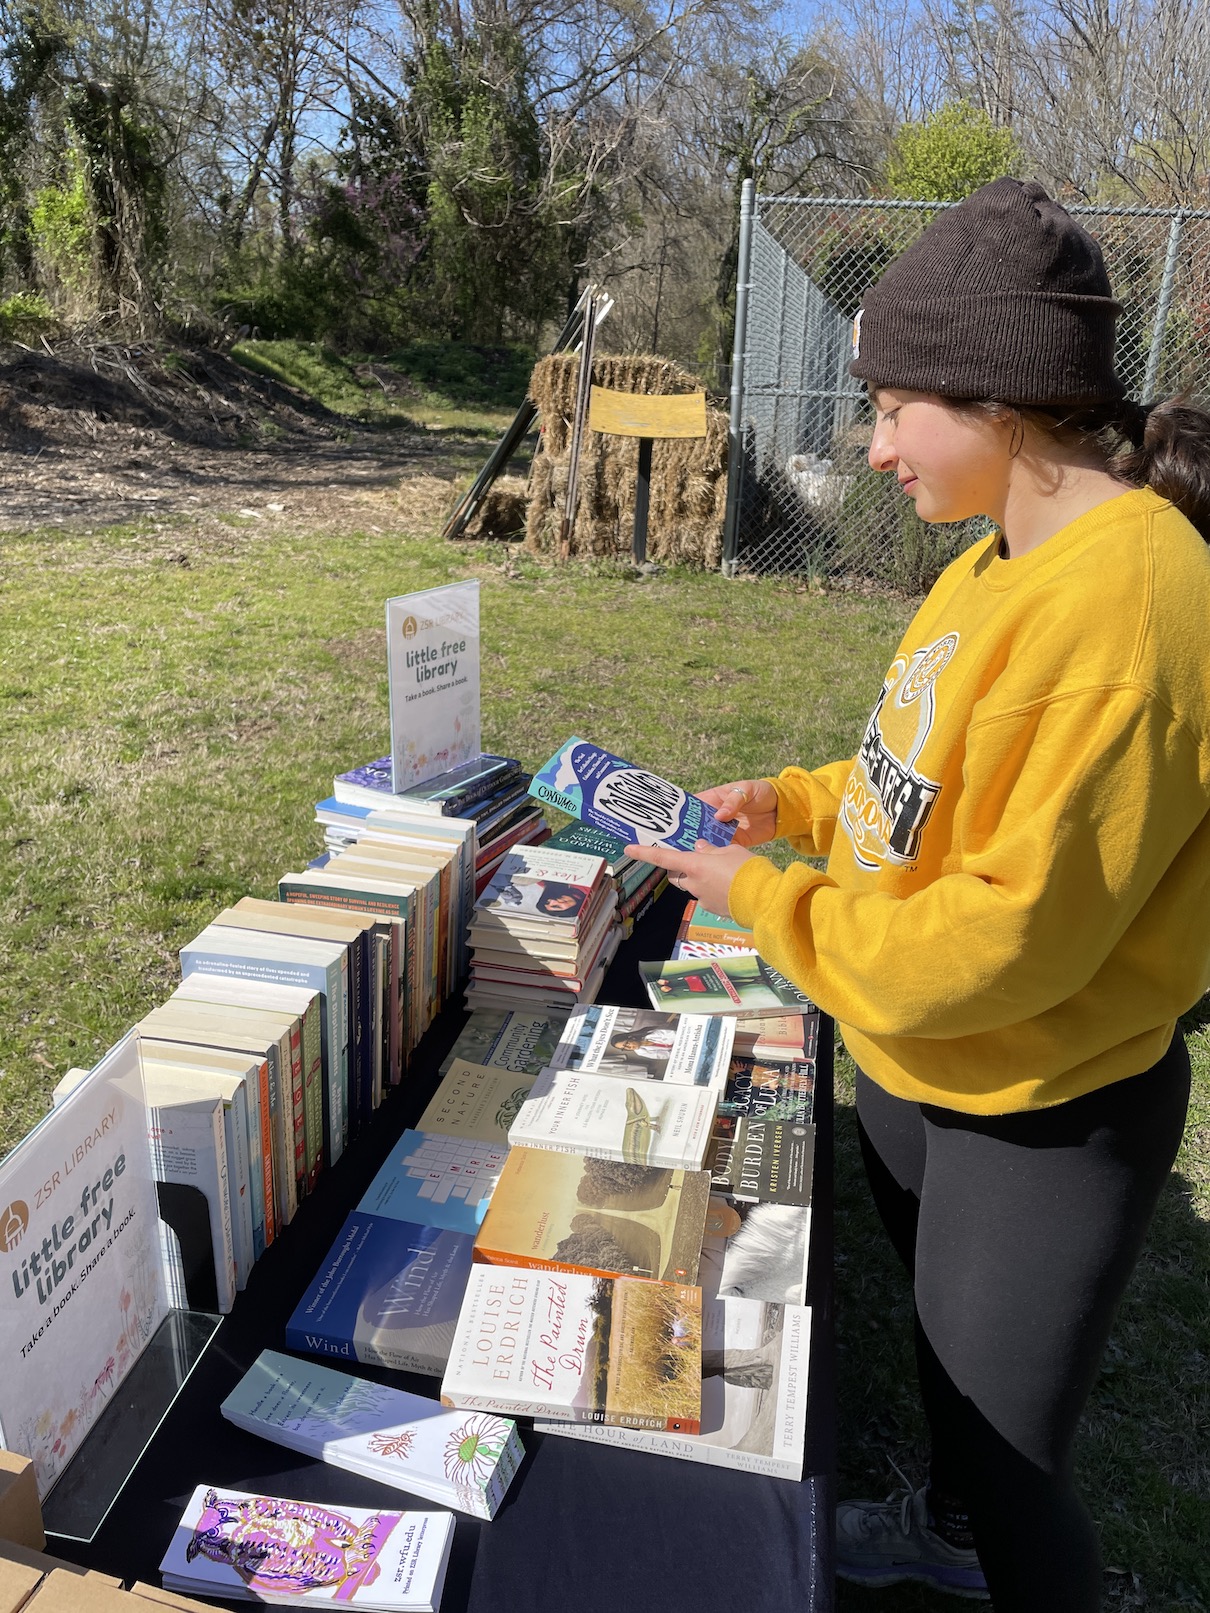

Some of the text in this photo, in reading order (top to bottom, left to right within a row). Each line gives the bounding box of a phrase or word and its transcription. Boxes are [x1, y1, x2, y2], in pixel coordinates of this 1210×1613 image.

[406, 640, 466, 668] little free
[416, 660, 458, 684] library
[405, 692, 417, 703] Take
[422, 686, 435, 696] book.
[437, 681, 450, 693] Share
[455, 676, 468, 687] book.
[538, 785, 577, 813] CONSUMED
[599, 772, 680, 833] CONSUMED
[686, 796, 703, 828] BARBER
[570, 835, 613, 848] WILSON
[570, 840, 616, 854] EDWARD
[535, 869, 583, 882] Alex &
[723, 933, 747, 944] Everyday
[198, 966, 228, 974] transformed
[242, 972, 278, 980] unprecedented
[279, 975, 308, 984] catastrophe
[202, 960, 246, 970] adrenaline-fueled
[277, 969, 299, 977] upended
[765, 966, 792, 991] ANNA
[331, 1002, 339, 1076] Displacements
[494, 1023, 528, 1067] Community
[506, 1021, 548, 1074] Gardening
[585, 1006, 615, 1069] What the Eyes Don't See
[684, 1023, 703, 1074] Mona Hanna-Attisha
[266, 1060, 276, 1107] Alex Me
[437, 1071, 471, 1123] SECOND
[451, 1074, 485, 1125] NATURE
[563, 1077, 580, 1096] FISH
[752, 1069, 781, 1117] OF LUNA
[796, 1063, 808, 1124] ULIA BUTTERFLY HILL
[549, 1117, 560, 1135] YOUR
[556, 1095, 571, 1118] INNER
[672, 1101, 688, 1137] NEIL SHUBIN
[33, 1107, 118, 1210] ZSR LIBRARY
[530, 1142, 576, 1154] INNER FISH
[712, 1139, 735, 1186] BODY
[740, 1121, 766, 1190] BURDEN
[769, 1125, 783, 1192] KRISTEN IVERSEN
[263, 1153, 273, 1222] AMERICAN CATCH
[11, 1153, 127, 1299] little free
[531, 1212, 550, 1250] wanderlust
[36, 1198, 116, 1306] library
[305, 1292, 322, 1314] Winner
[321, 1278, 329, 1286] the
[326, 1266, 338, 1279] John
[333, 1241, 352, 1266] Burroughs
[346, 1224, 359, 1240] Medal
[504, 1257, 519, 1265] Solnit
[19, 1209, 137, 1360] Take a book. Share a book.
[377, 1247, 436, 1317] Wind
[427, 1290, 438, 1307] Shaped
[440, 1268, 448, 1280] Myth
[450, 1244, 458, 1256] Land
[415, 1303, 423, 1315] How
[456, 1273, 485, 1376] NATIONAL BESTSELLER
[472, 1284, 505, 1366] LOUISE
[493, 1277, 529, 1381] ERDRICH
[539, 1278, 568, 1351] Painted
[305, 1335, 350, 1356] Wind
[377, 1356, 397, 1364] Shaped
[411, 1362, 427, 1370] Myth
[558, 1317, 589, 1376] Drum
[531, 1355, 557, 1390] The
[782, 1313, 801, 1447] TERRY TEMPEST WILLIAMS
[249, 1382, 275, 1416] Handle book
[263, 1400, 281, 1420] bee does
[461, 1395, 570, 1419] The Painted Drum
[581, 1410, 663, 1428] LOUISE ERDRICH
[583, 1424, 694, 1454] HOUR of LAND
[725, 1453, 791, 1470] TERRY TEMPEST
[736, 1461, 779, 1474] WILLIAMS
[394, 1524, 416, 1583] zsr.wfu.edu
[402, 1575, 412, 1595] Printed
[409, 1556, 417, 1568] ZSR
[413, 1540, 421, 1558] Library
[419, 1516, 428, 1540] letterpress
